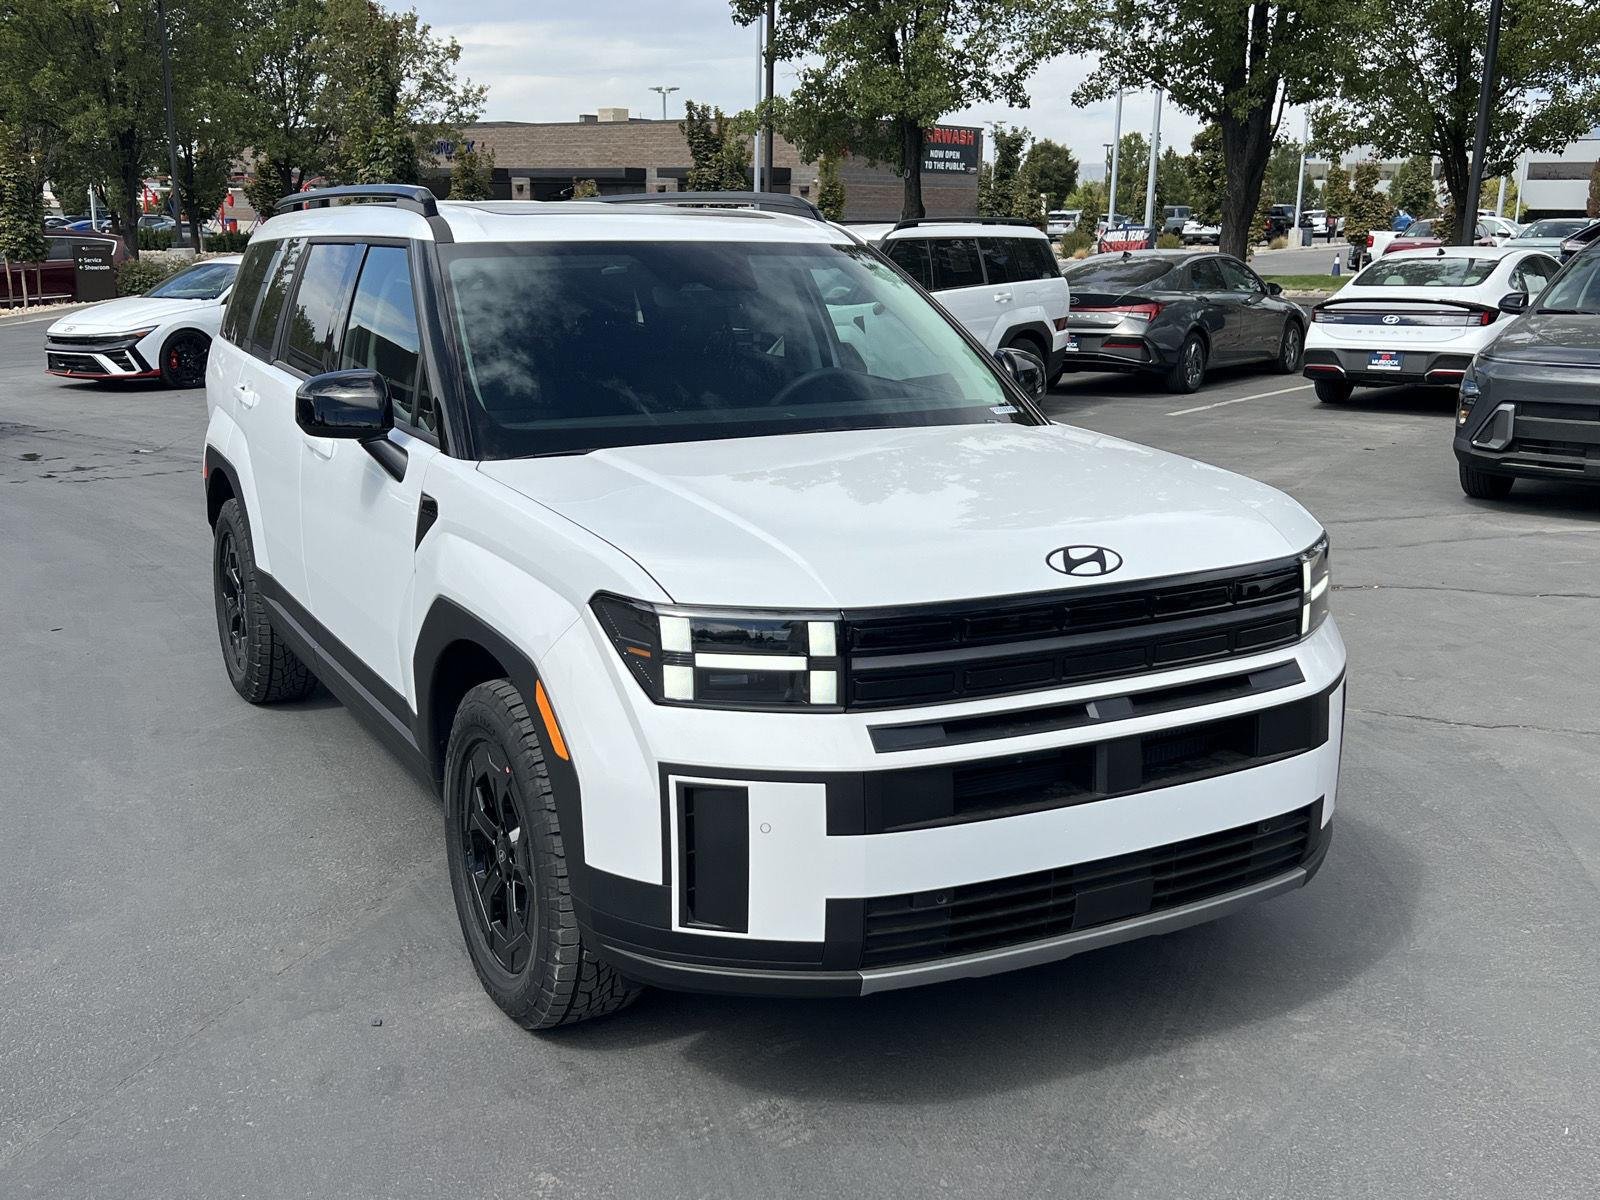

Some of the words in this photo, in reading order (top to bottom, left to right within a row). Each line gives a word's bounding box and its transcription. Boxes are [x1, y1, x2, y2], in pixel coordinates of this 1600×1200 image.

[930, 150, 944, 158] NOW
[945, 151, 960, 159] OPEN
[925, 161, 932, 169] TO
[945, 162, 966, 170] PUBLIC
[1105, 231, 1127, 242] MODEL
[1127, 230, 1146, 241] YEAR
